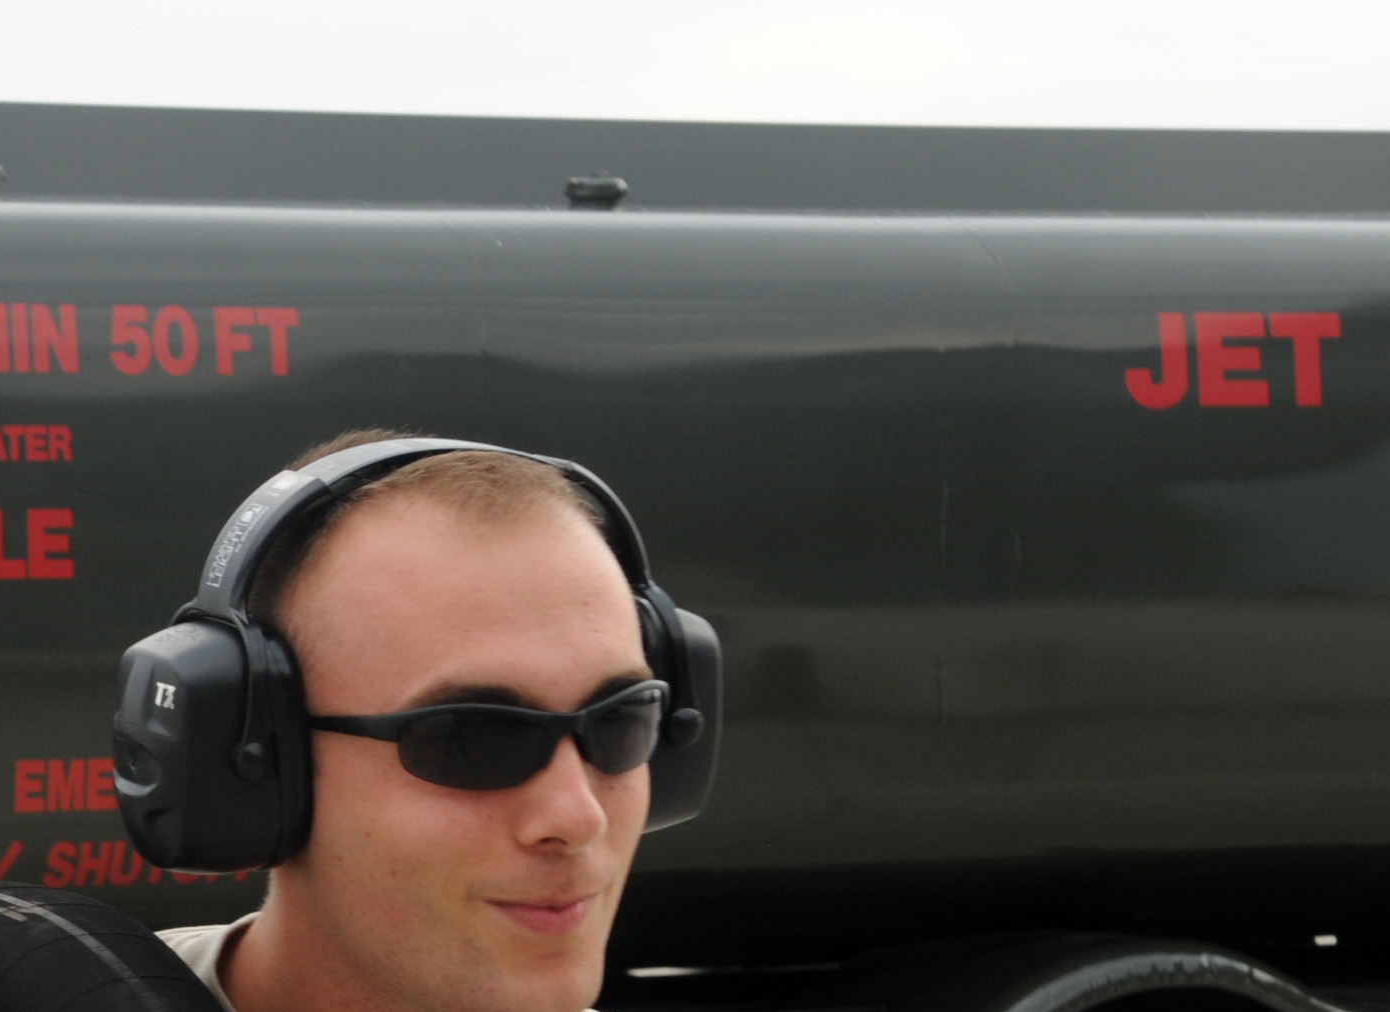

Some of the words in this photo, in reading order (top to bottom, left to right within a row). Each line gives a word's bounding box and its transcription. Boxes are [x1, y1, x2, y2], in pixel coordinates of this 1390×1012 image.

[110, 304, 199, 377] 50
[213, 306, 299, 376] FT
[1124, 311, 1342, 410] JET
